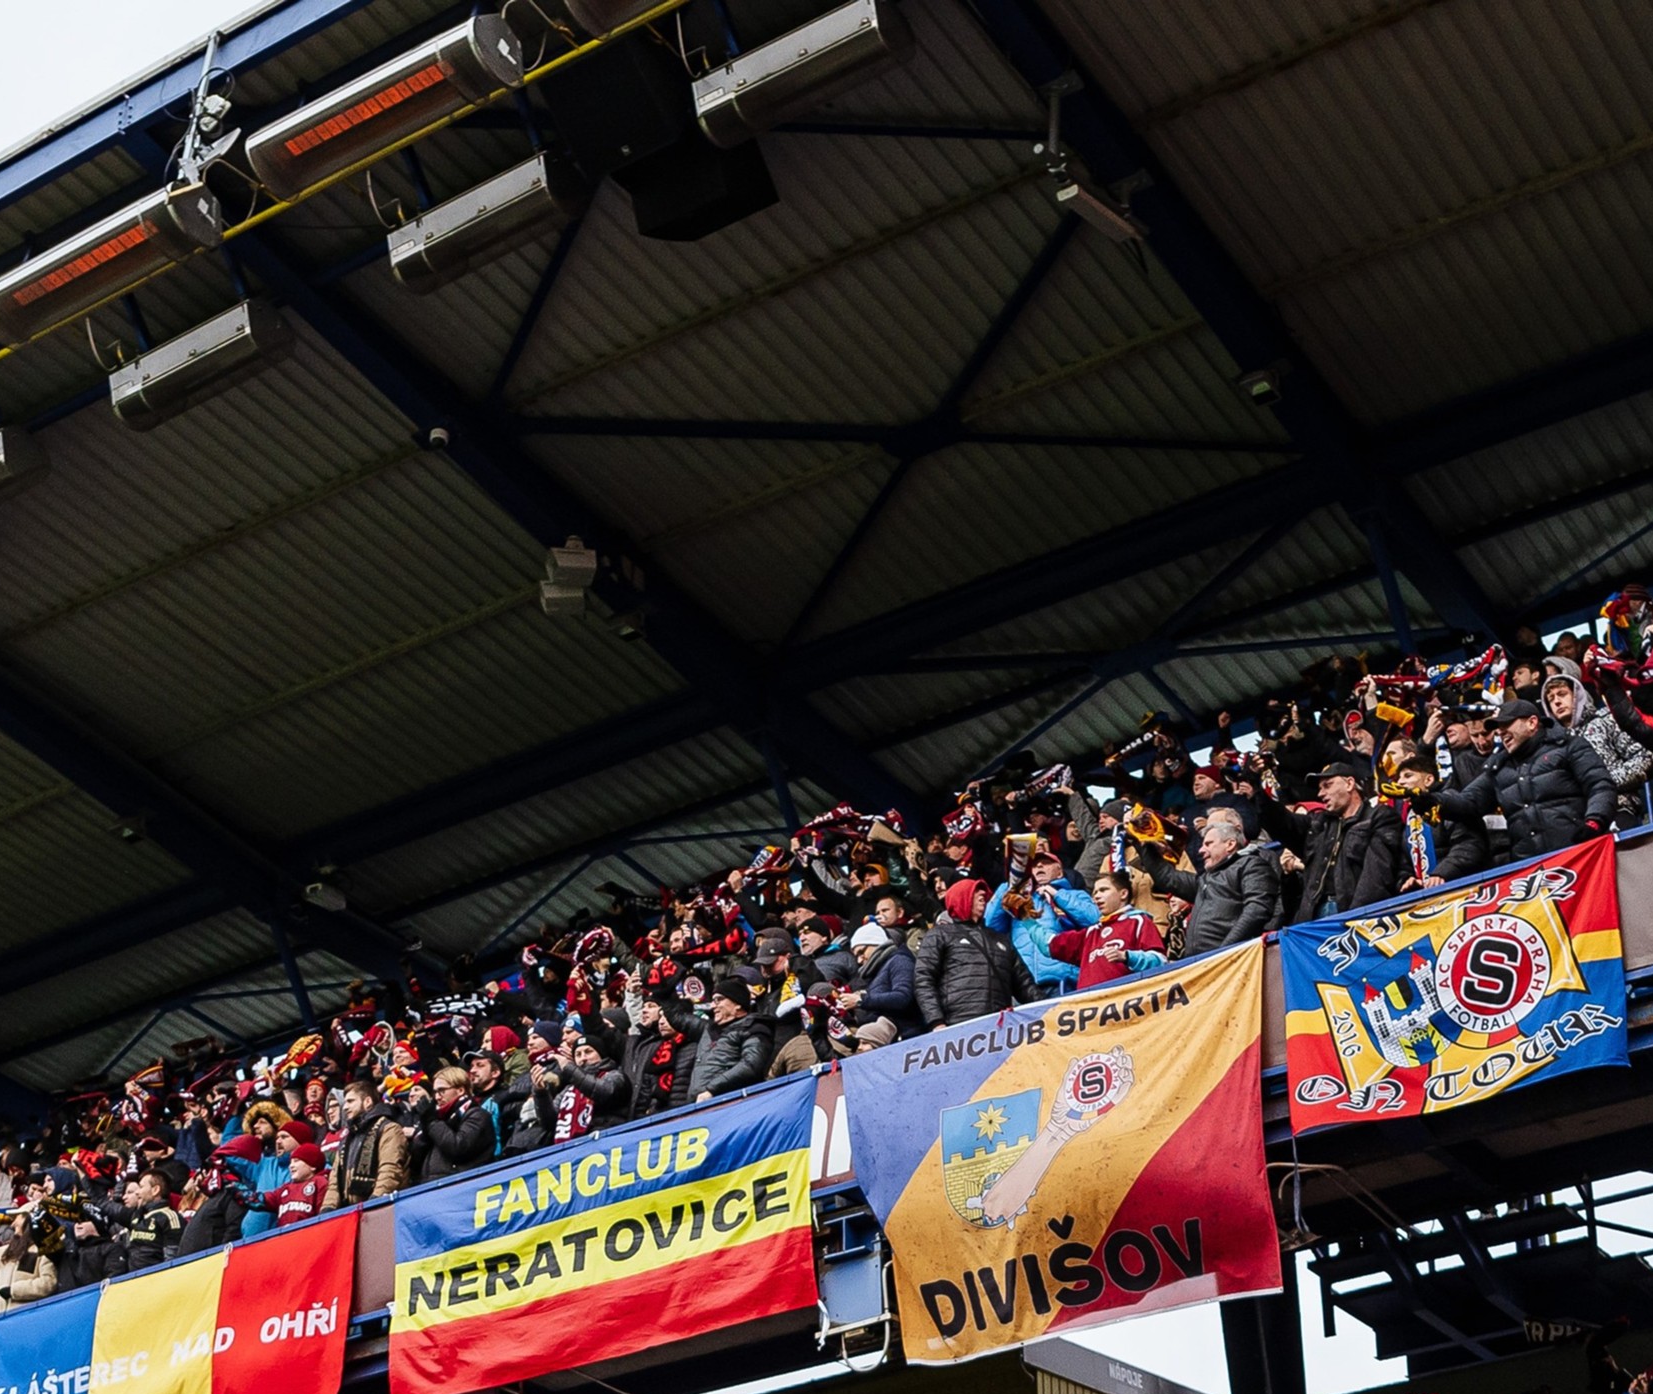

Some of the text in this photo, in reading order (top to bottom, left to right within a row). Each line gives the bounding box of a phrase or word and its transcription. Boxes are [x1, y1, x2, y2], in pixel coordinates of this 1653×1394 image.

[1438, 917, 1547, 1007] AC SPARTA PRAHA
[1463, 937, 1520, 1007] S
[902, 982, 1191, 1074] FANCLUB SPARTA
[1331, 1010, 1361, 1058] 2016
[1448, 1004, 1511, 1032] FOTBAL
[1080, 1065, 1104, 1100] S
[474, 1127, 711, 1229] FANCLUB
[408, 1172, 791, 1316] NERATOVICE
[919, 1213, 1203, 1339] DIVIŠOV
[170, 1326, 236, 1367] NAD
[259, 1297, 340, 1344] OHŘÍ
